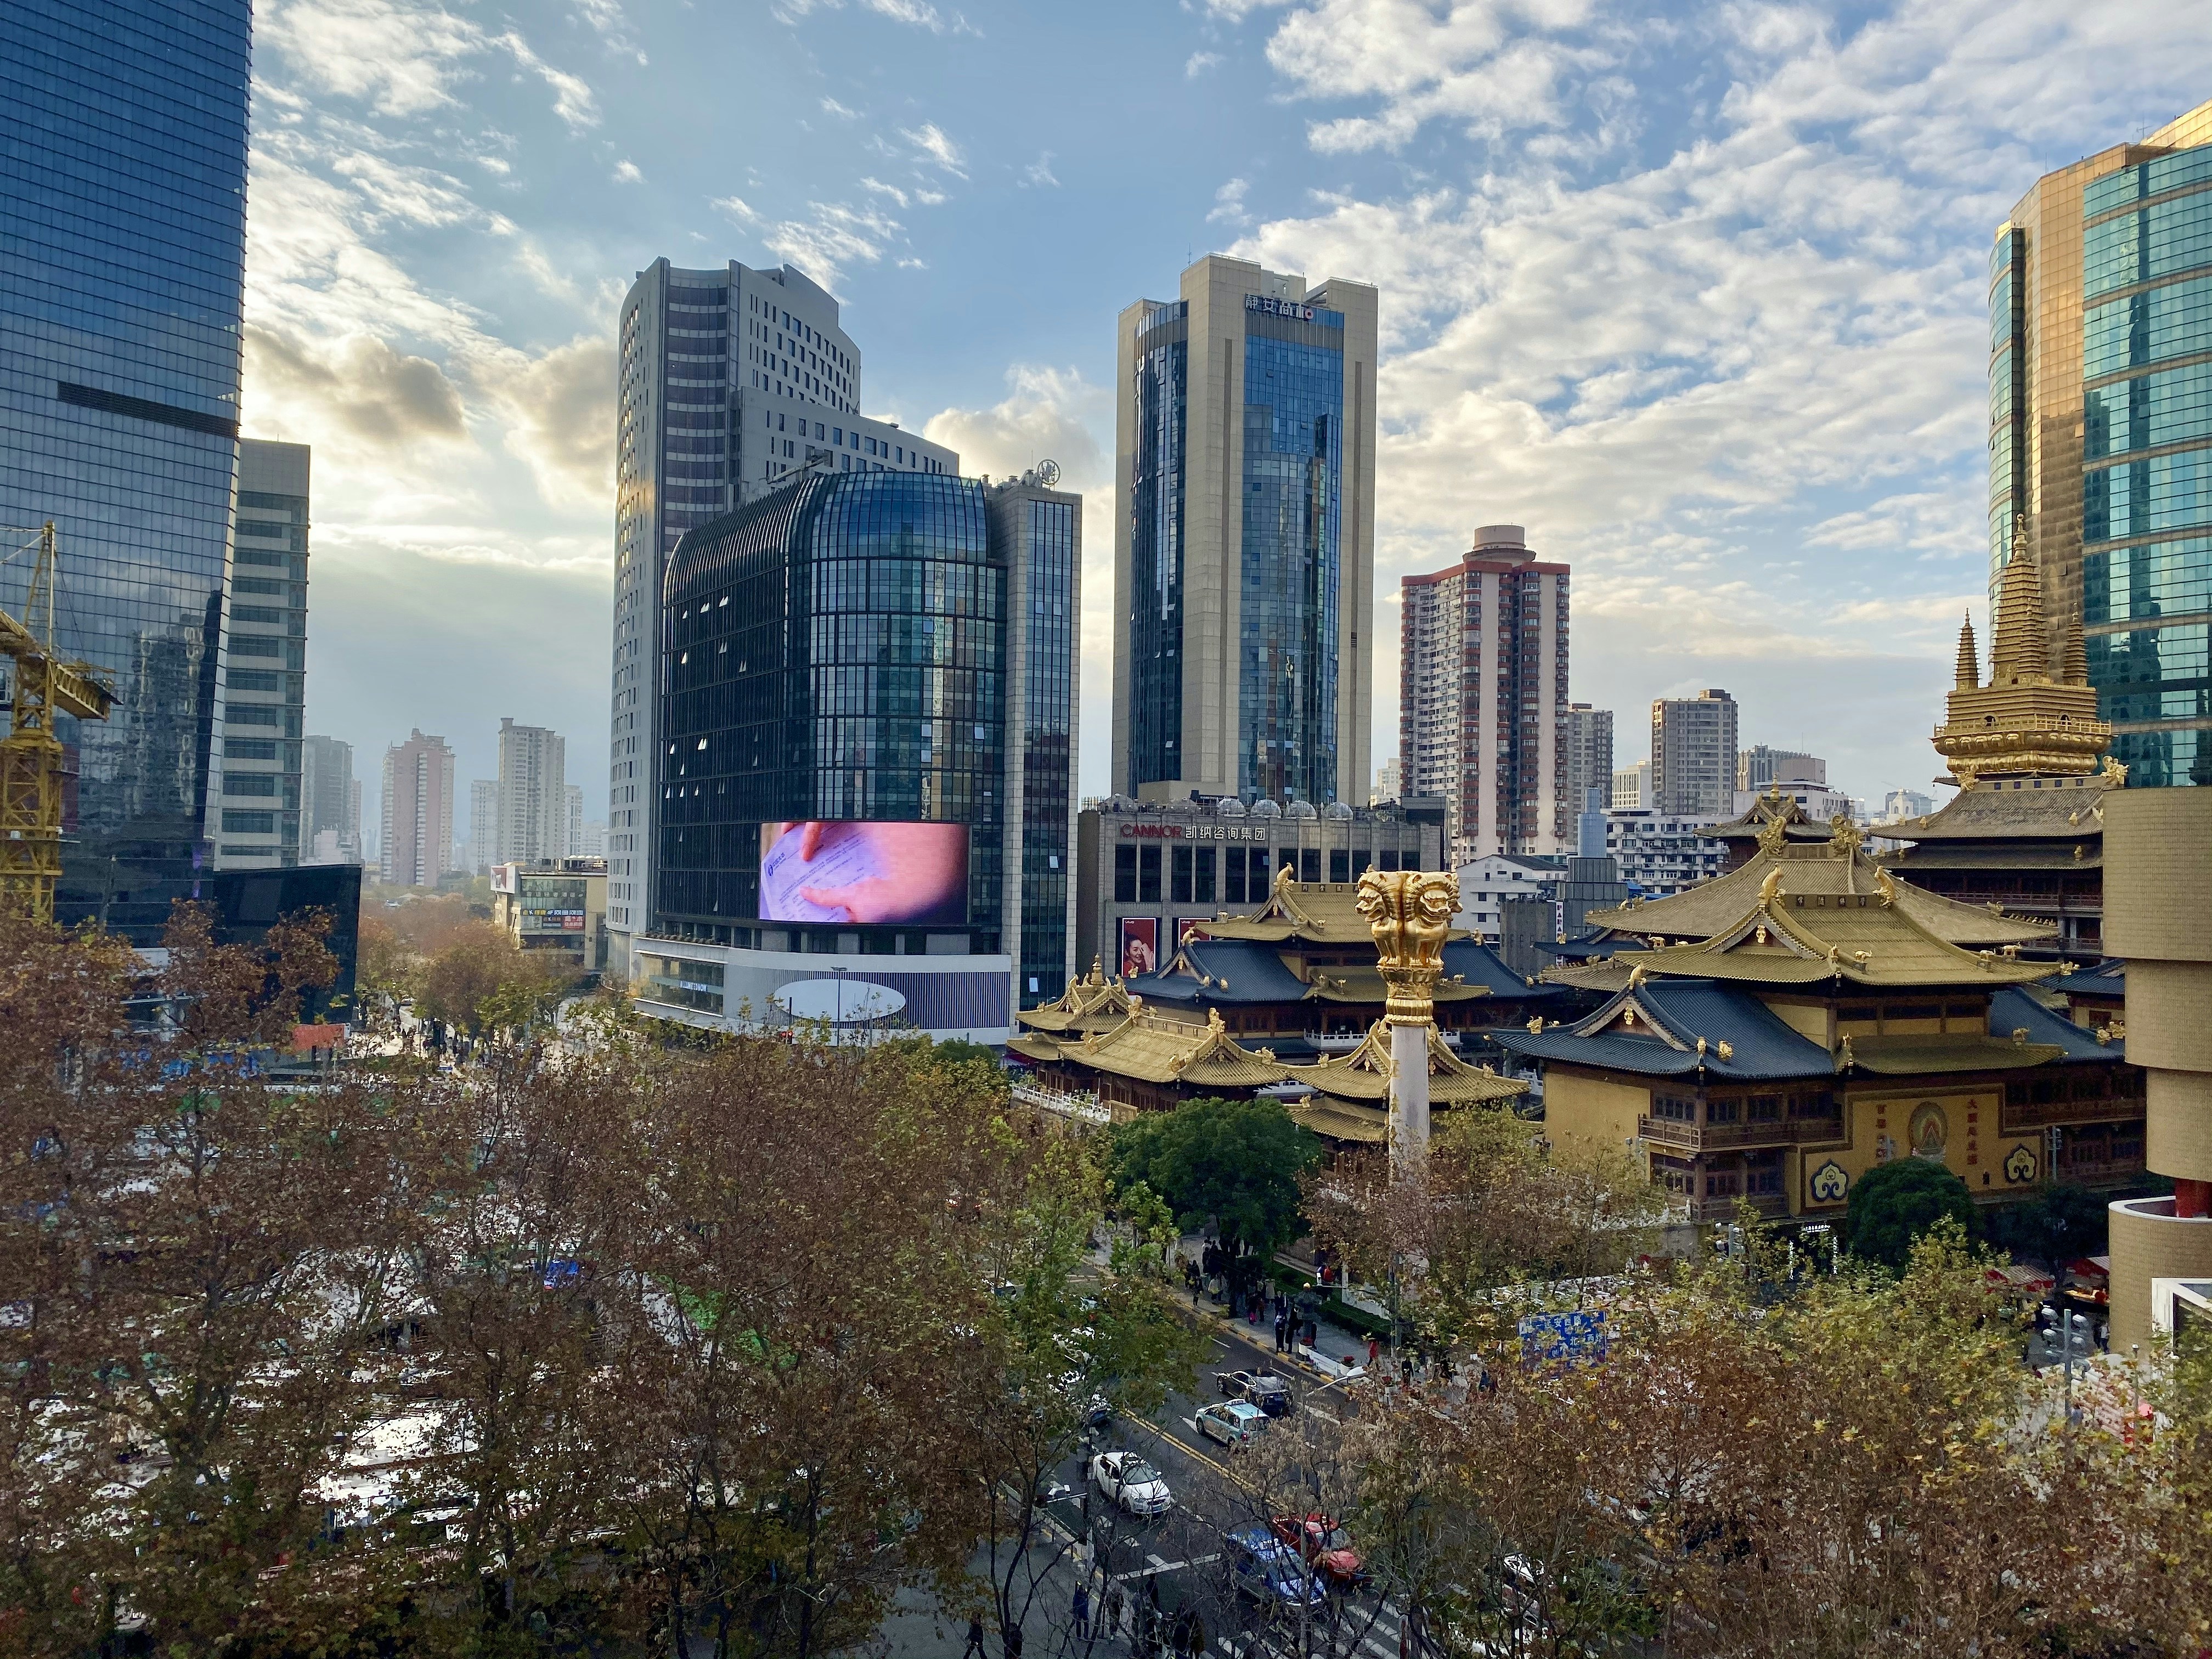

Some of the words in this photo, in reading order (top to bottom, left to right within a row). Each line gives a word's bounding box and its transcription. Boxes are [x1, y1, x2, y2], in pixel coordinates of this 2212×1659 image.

[1121, 824, 1182, 838] CANNOR
[1185, 825, 1265, 840] 凯纳咨询集团
